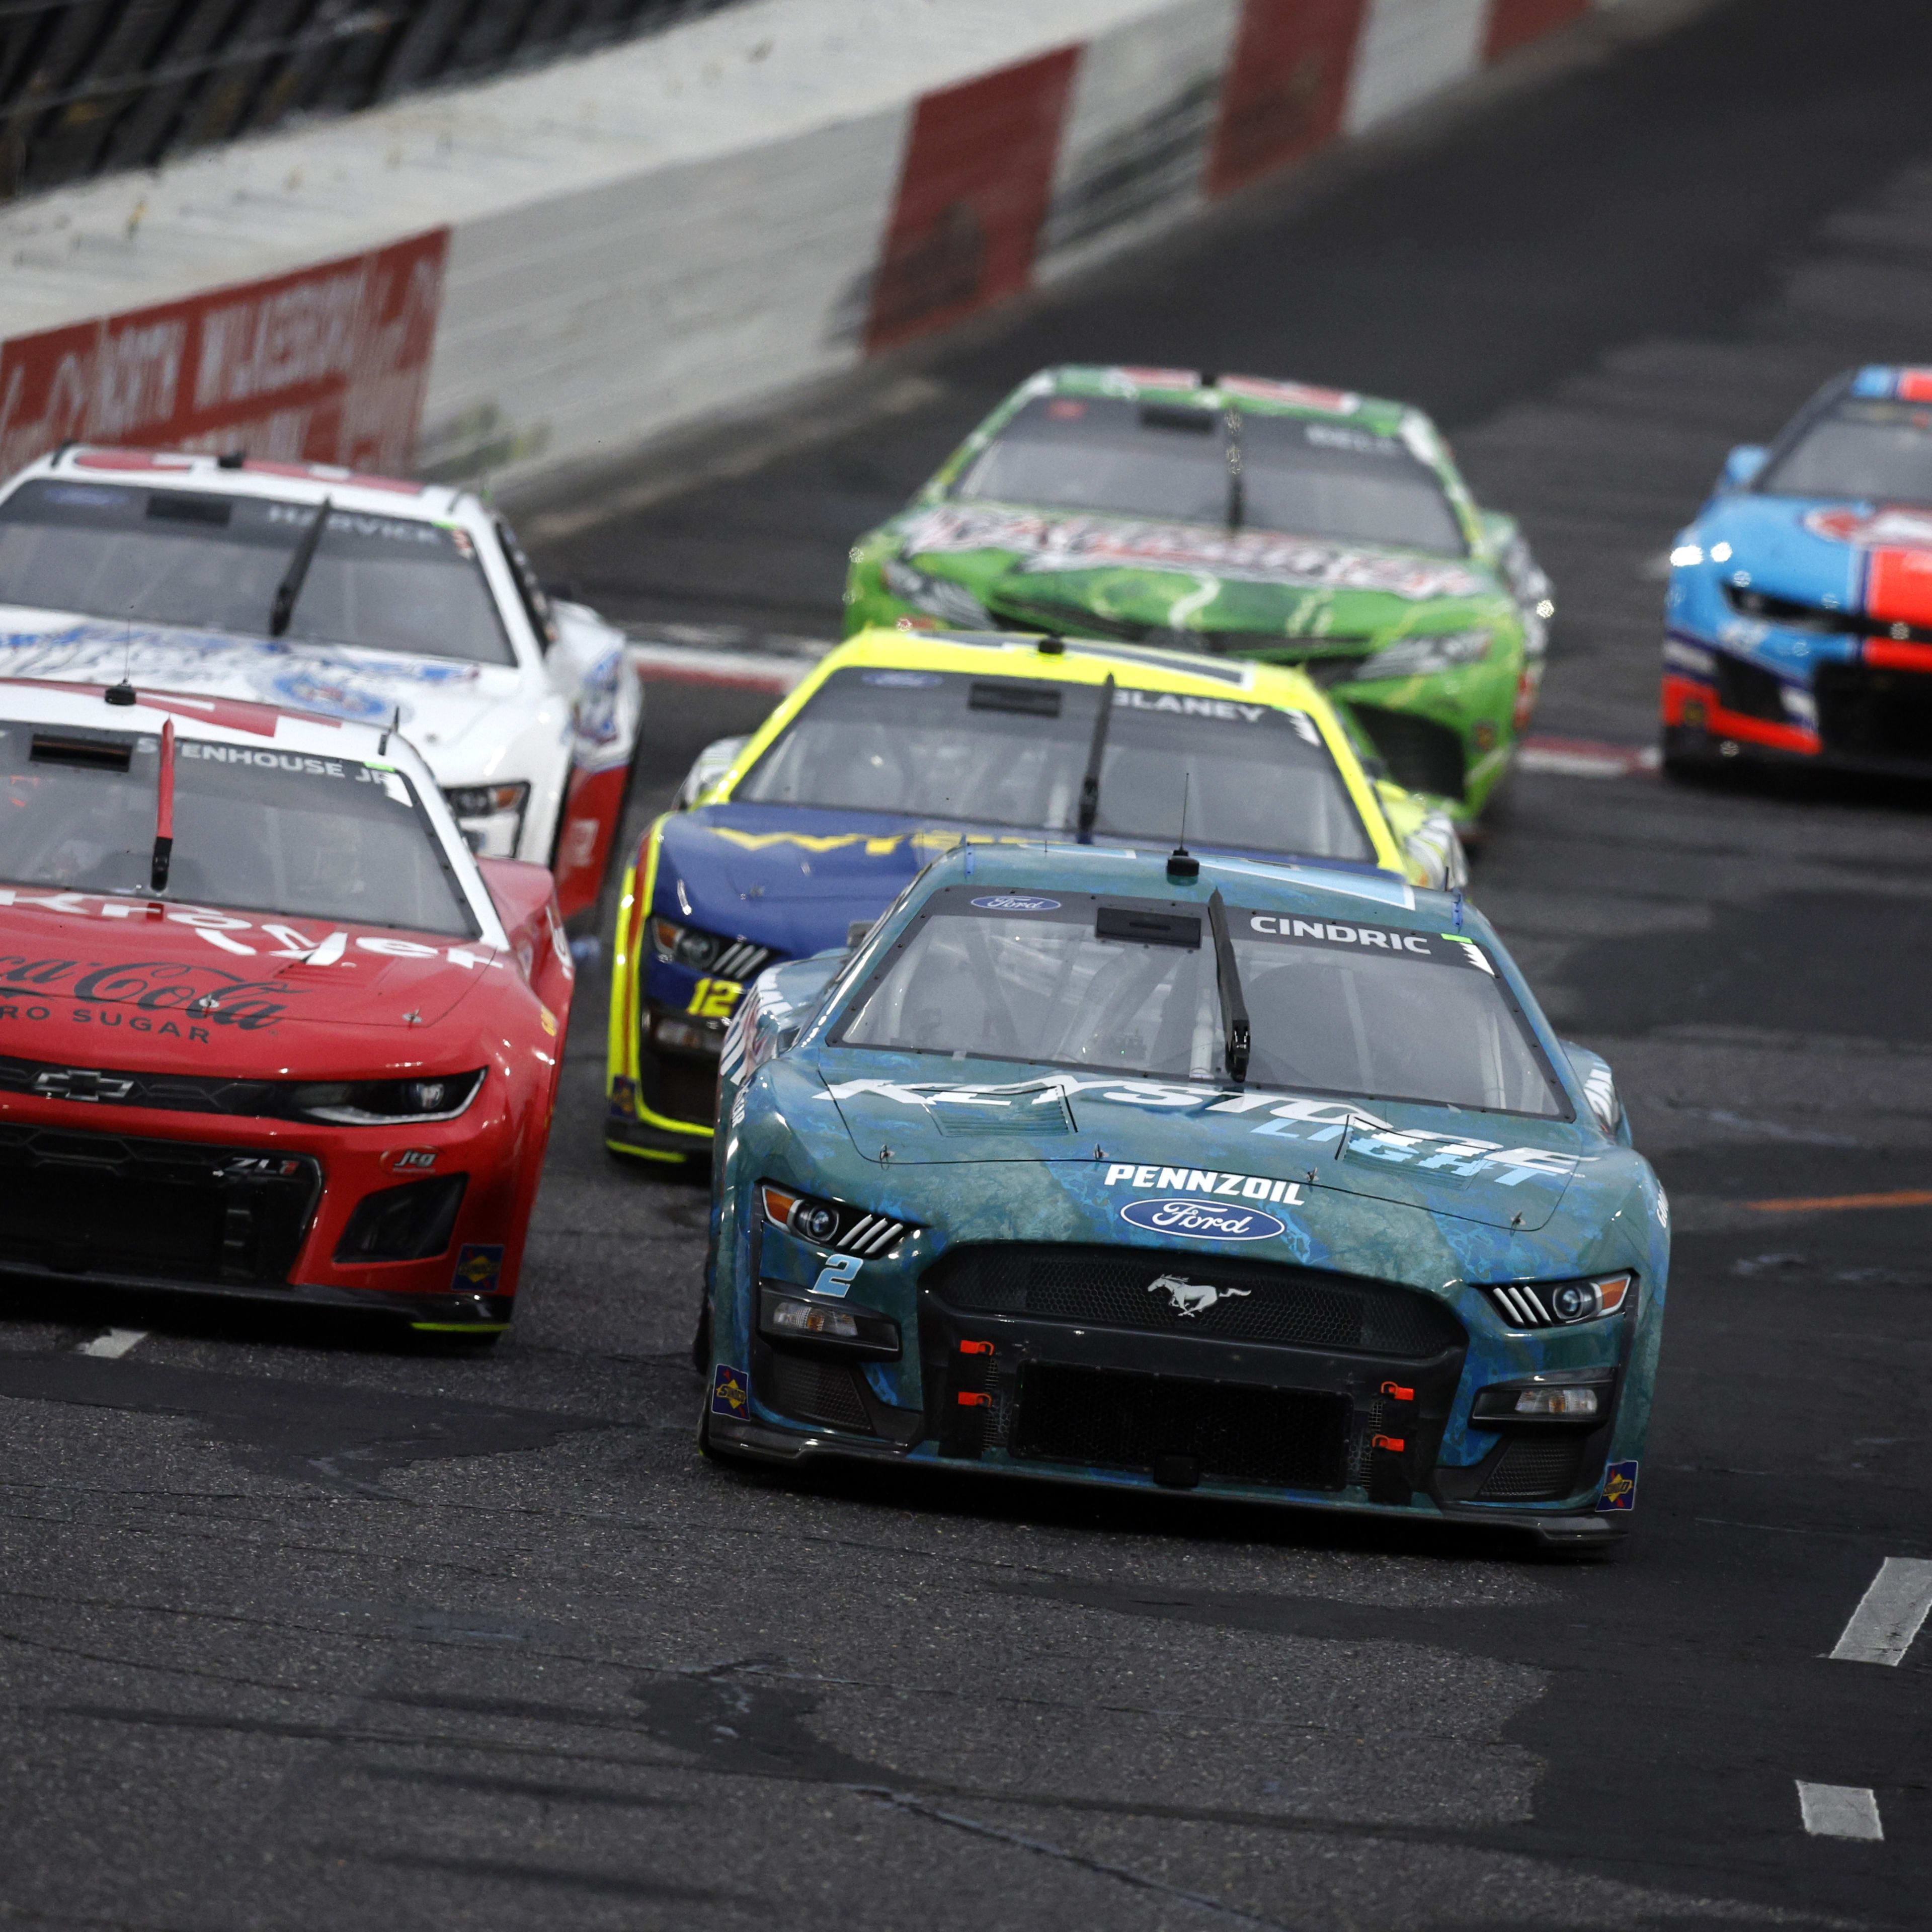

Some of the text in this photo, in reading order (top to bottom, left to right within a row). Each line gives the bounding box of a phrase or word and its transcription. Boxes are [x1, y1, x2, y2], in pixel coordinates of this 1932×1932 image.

[1113, 689, 1266, 722] BLANEY
[137, 738, 345, 777] SENHOUSE
[1250, 916, 1431, 955] CINDRIC
[686, 978, 742, 1017] 12
[72, 1008, 210, 1044] SUGAR
[812, 1075, 1601, 1174] KEYSTONE
[1250, 1118, 1560, 1185] LIGHT
[1104, 1164, 1305, 1205] PENNZOIL
[1152, 1202, 1253, 1234] Ford
[813, 1253, 863, 1298] 2
